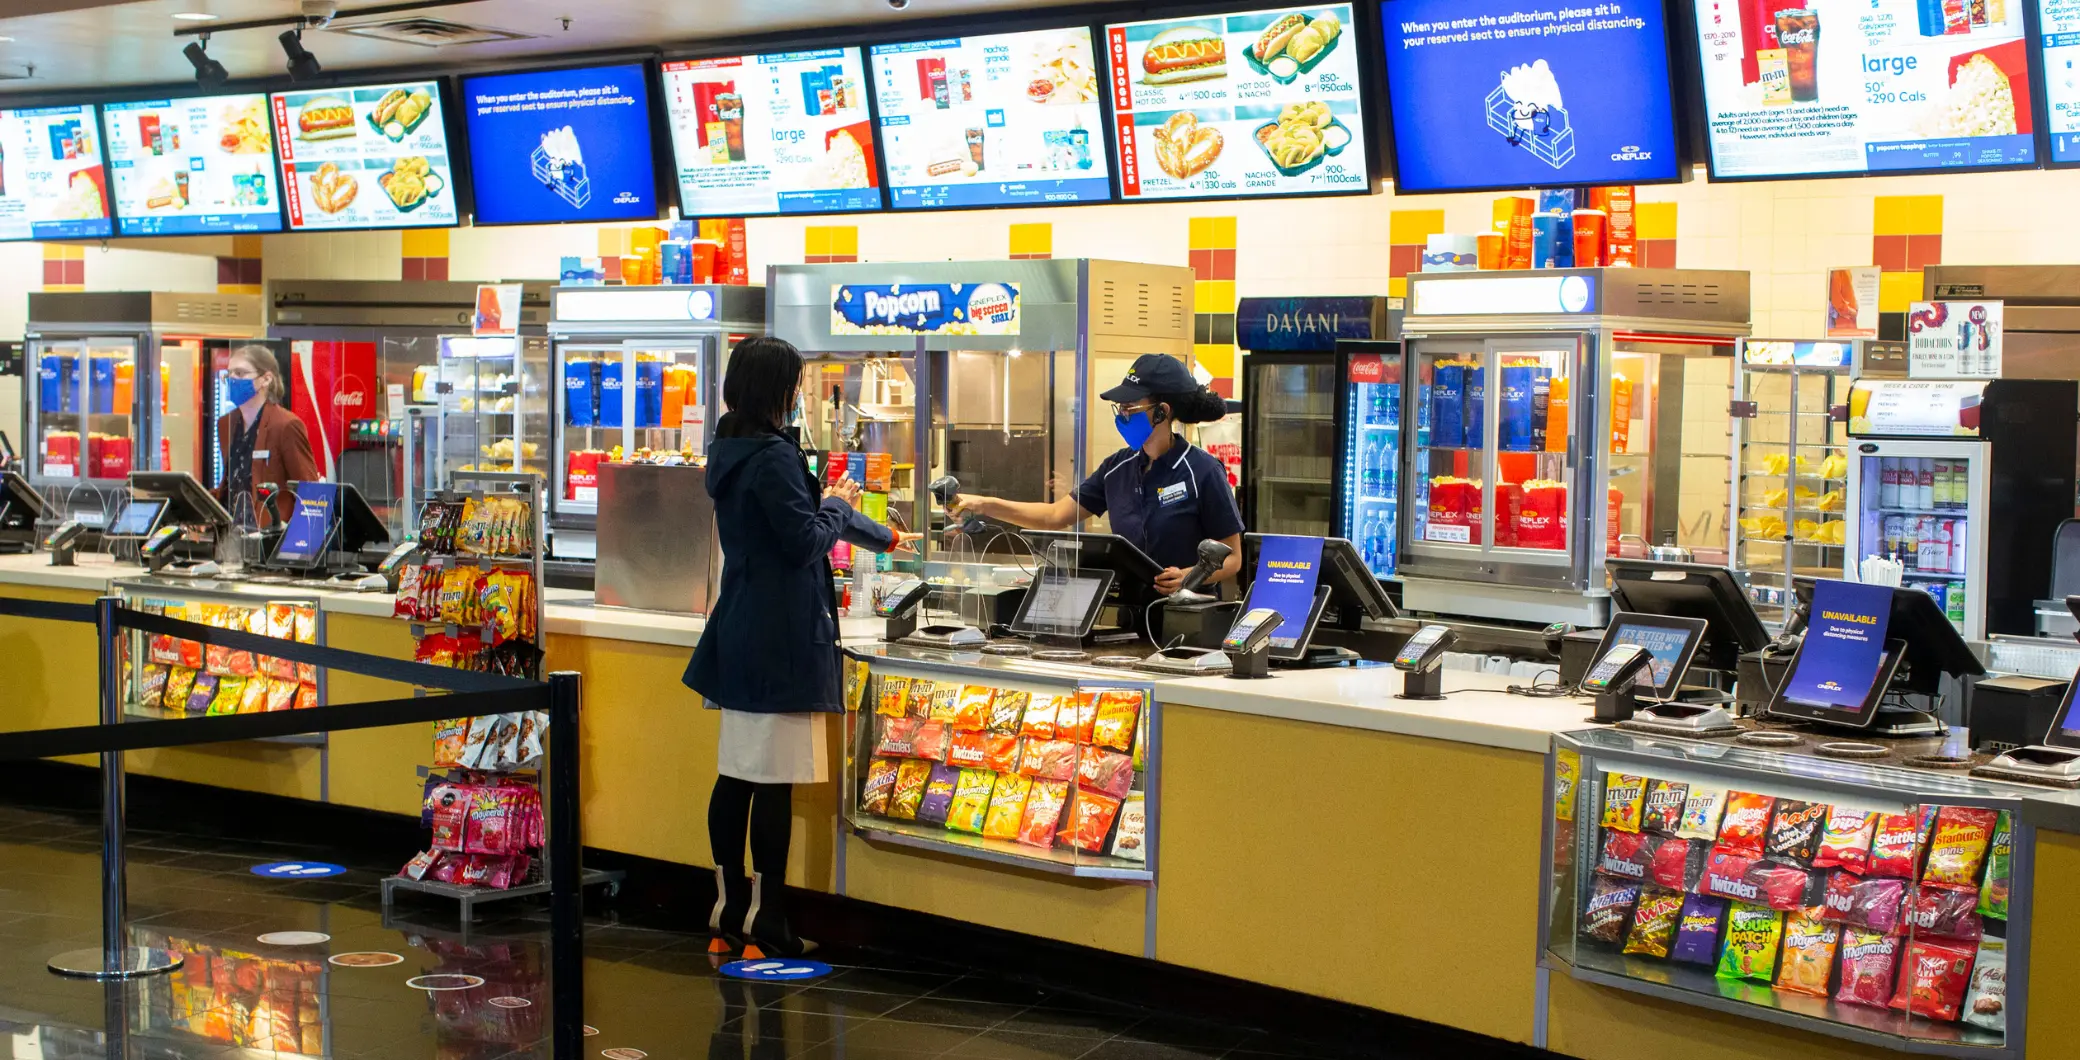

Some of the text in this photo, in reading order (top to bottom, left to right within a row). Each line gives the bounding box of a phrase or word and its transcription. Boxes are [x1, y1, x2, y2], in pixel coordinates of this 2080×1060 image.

[1401, 3, 1620, 34] When you enter the auditorium, please sit in
[1403, 16, 1646, 49] your reserved seat to ensure physical distancing.
[2046, 36, 2053, 46] 5
[984, 45, 1009, 53] nachos
[984, 53, 1010, 65] grande
[1861, 53, 1918, 75] large
[1113, 33, 1128, 107] HOT DOGS
[476, 85, 619, 105] When you enter the auditorium, please sit in
[1135, 89, 1164, 97] CLASSIC
[1211, 90, 1227, 98] cals
[1867, 91, 1926, 104] +290 Cals
[477, 106, 492, 116] your
[493, 103, 520, 113] reserved
[521, 102, 536, 111] seat
[537, 101, 545, 110] to
[546, 101, 568, 109] ensure
[569, 98, 596, 109] physical
[1151, 97, 1166, 105] DOG
[1750, 110, 1767, 119] youth
[1768, 109, 1785, 118] (ages
[1805, 106, 1824, 114] older)
[1712, 120, 1735, 128] average
[1840, 112, 1858, 120] (ages
[1738, 125, 1752, 133] need
[1762, 124, 1786, 132] average
[1768, 131, 1797, 139] individual
[1816, 130, 1831, 138] vary.
[771, 128, 806, 144] large
[1876, 144, 1899, 152] popcorn
[1900, 143, 1926, 152] toppings
[1123, 126, 1135, 184] SNACKS
[1611, 152, 1651, 162] CINEPLEX
[1245, 171, 1277, 179] NACHOS
[1204, 180, 1237, 189] 330 cals
[1246, 179, 1276, 187] GRANDE
[288, 171, 300, 219] SNACKS
[865, 290, 940, 324] Popcorn
[968, 294, 1007, 307] CINEPLEX
[971, 302, 1008, 320] big screen
[991, 312, 1009, 324] snax
[1972, 310, 1985, 320] NEW!
[1266, 308, 1339, 338] DASANI
[1353, 361, 1380, 375] Coca-Cola
[334, 391, 364, 406] Coca-Cola
[1268, 561, 1311, 570] UNAVAILABLE
[1821, 610, 1877, 625] UNAVAILABLE
[1620, 628, 1688, 645] IT'S BETTER WITH
[1823, 631, 1868, 642] distancing measures
[1845, 628, 1864, 636] physical
[153, 648, 179, 661] Twizzlers
[1817, 683, 1843, 692] CINEPLEX
[953, 744, 985, 761] Twizzlers
[471, 808, 505, 821] Maynards
[1722, 807, 1767, 834] Maltesers
[1772, 803, 1824, 835] Mars
[1877, 831, 1927, 848] Skittles
[1935, 828, 1985, 845] Starburst
[1939, 845, 1965, 857] minis
[1604, 854, 1644, 878] Twizzlers
[1709, 873, 1758, 900] Twizzlers
[1588, 887, 1637, 912] SNICKERS
[1734, 919, 1772, 931] SOUR
[1732, 930, 1772, 944] PATCH
[1787, 929, 1836, 949] Maynards
[1843, 940, 1893, 961] Maynards
